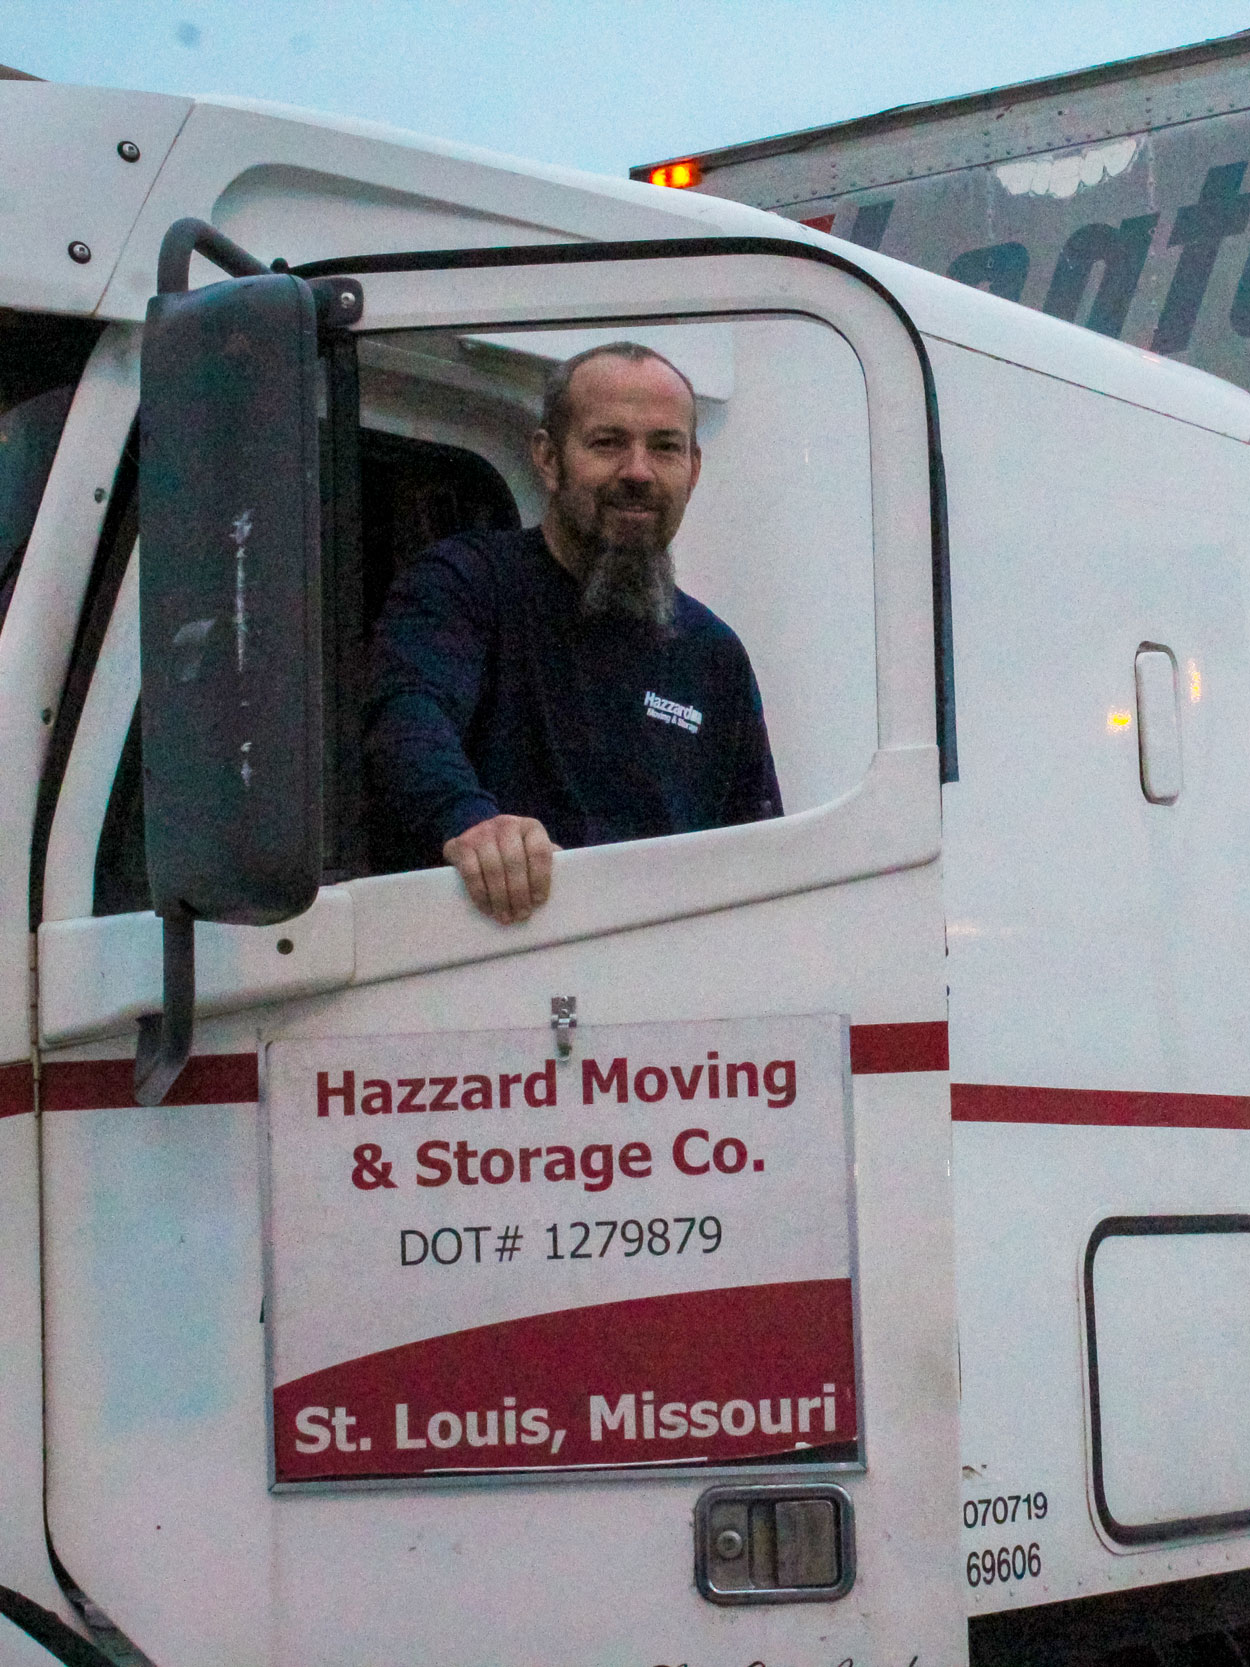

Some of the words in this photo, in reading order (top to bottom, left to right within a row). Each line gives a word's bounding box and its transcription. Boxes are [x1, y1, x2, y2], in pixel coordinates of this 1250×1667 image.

[317, 1060, 558, 1117] Hazzard
[582, 1051, 796, 1109] Moving
[351, 1143, 398, 1191] &
[416, 1141, 653, 1192] Storage
[672, 1128, 765, 1176] Co.
[400, 1225, 524, 1266] DOT#
[546, 1216, 723, 1261] 1279879
[296, 1406, 371, 1453] St.
[395, 1397, 566, 1454] Louis,
[589, 1384, 836, 1442] Missouri
[963, 1491, 1048, 1529] 070719
[966, 1542, 1042, 1588] 69606
